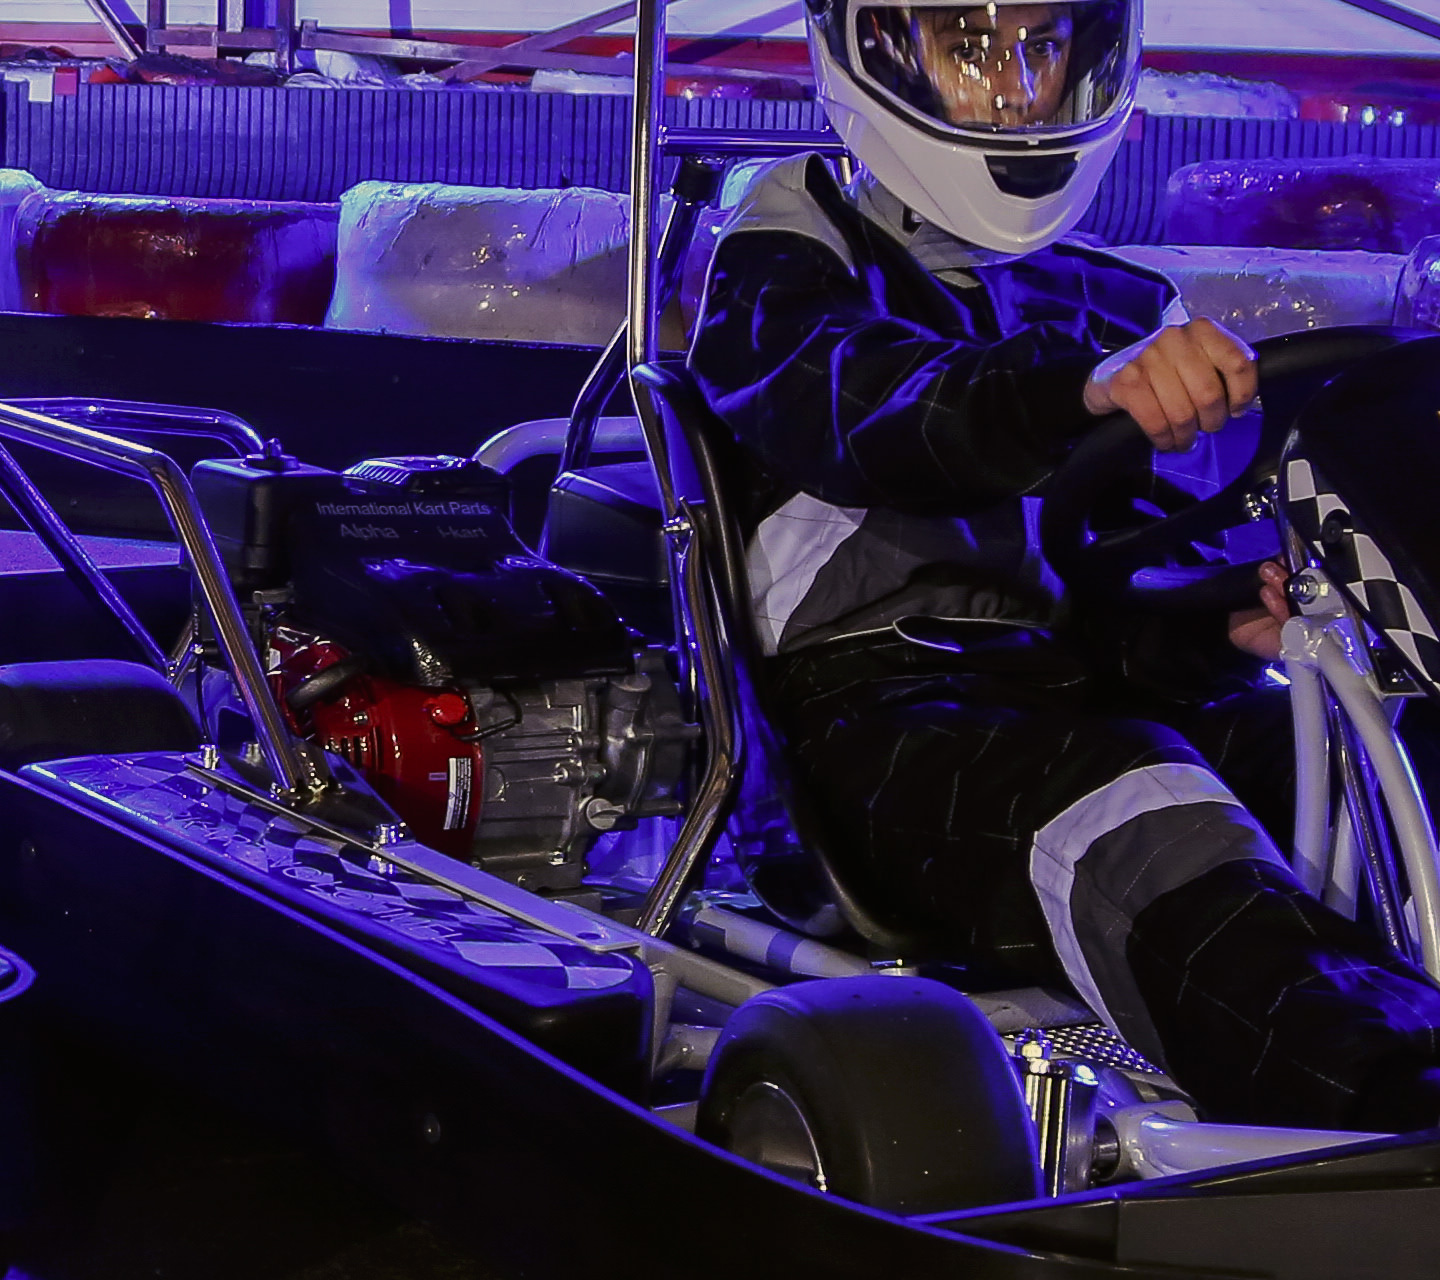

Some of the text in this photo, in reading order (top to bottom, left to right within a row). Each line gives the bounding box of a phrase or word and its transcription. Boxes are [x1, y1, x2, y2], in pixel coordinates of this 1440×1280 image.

[315, 500, 492, 516] International Kart Parts
[339, 522, 400, 541] Alpha
